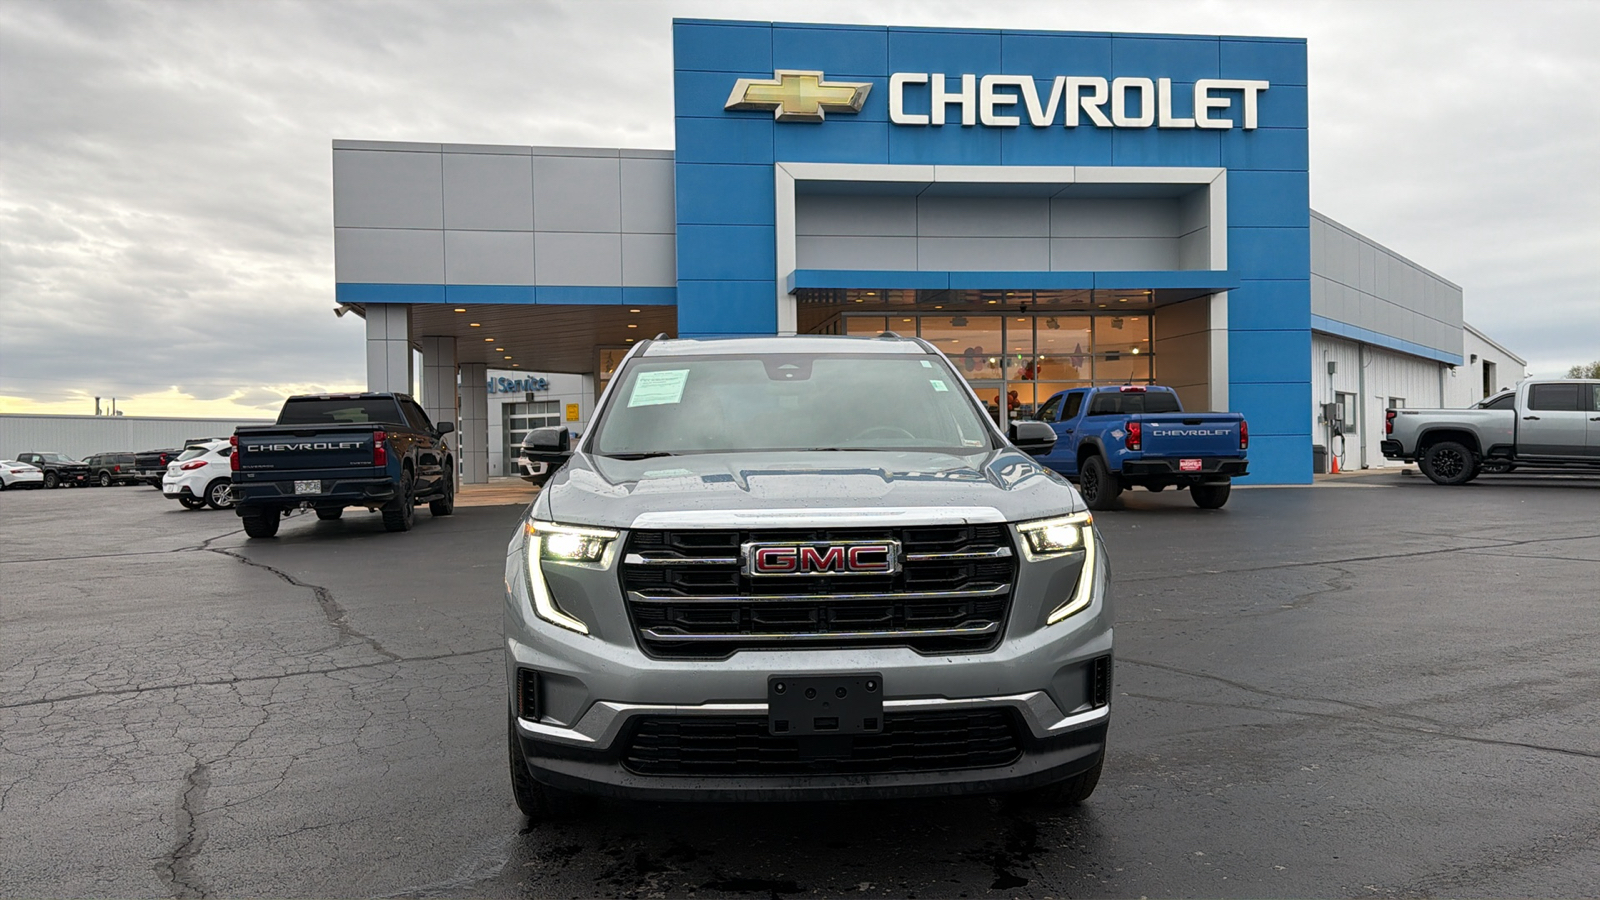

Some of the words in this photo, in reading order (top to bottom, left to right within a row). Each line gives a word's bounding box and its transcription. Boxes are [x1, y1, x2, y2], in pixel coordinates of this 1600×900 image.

[889, 72, 1270, 130] CHEVROLET
[498, 375, 548, 393] Service
[247, 441, 364, 452] CHEVROLET
[756, 546, 889, 572] GMC
